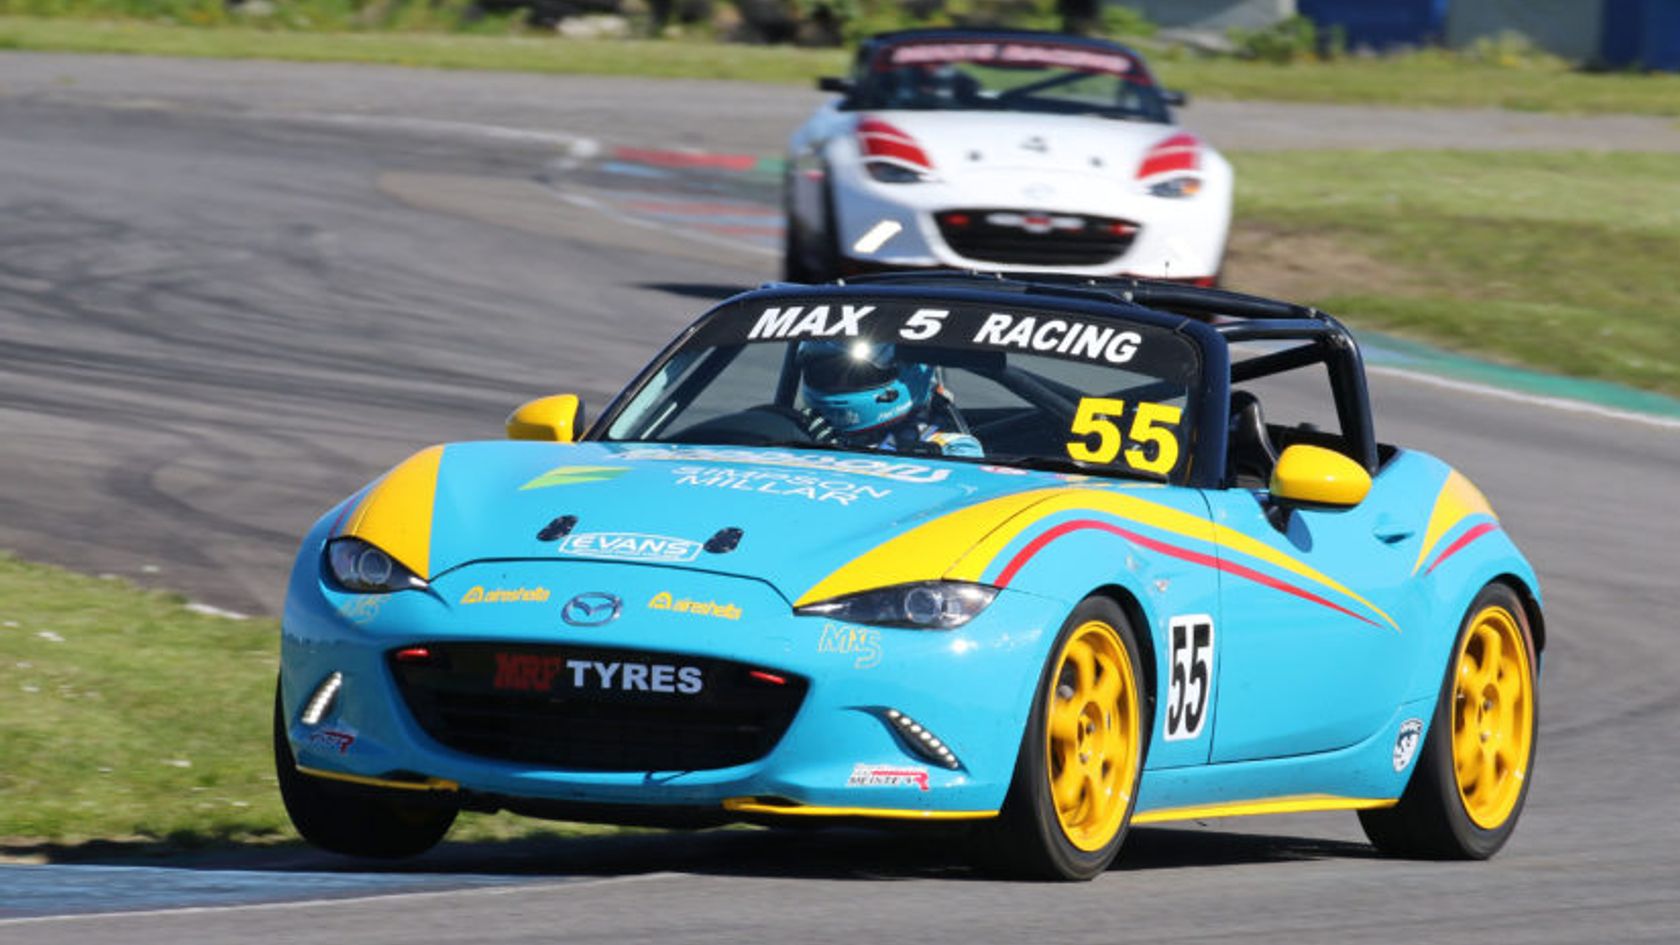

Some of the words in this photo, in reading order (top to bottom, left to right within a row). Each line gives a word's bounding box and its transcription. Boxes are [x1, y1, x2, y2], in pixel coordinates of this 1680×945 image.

[747, 304, 877, 340] MAX
[899, 308, 950, 341] 5
[973, 313, 1141, 364] RACING
[1066, 397, 1184, 475] 55
[672, 465, 892, 498] SIMPSON
[675, 475, 859, 506] MILLAR
[571, 535, 691, 554] EVANS
[565, 659, 704, 695] TYRES
[1167, 622, 1212, 736] 55
